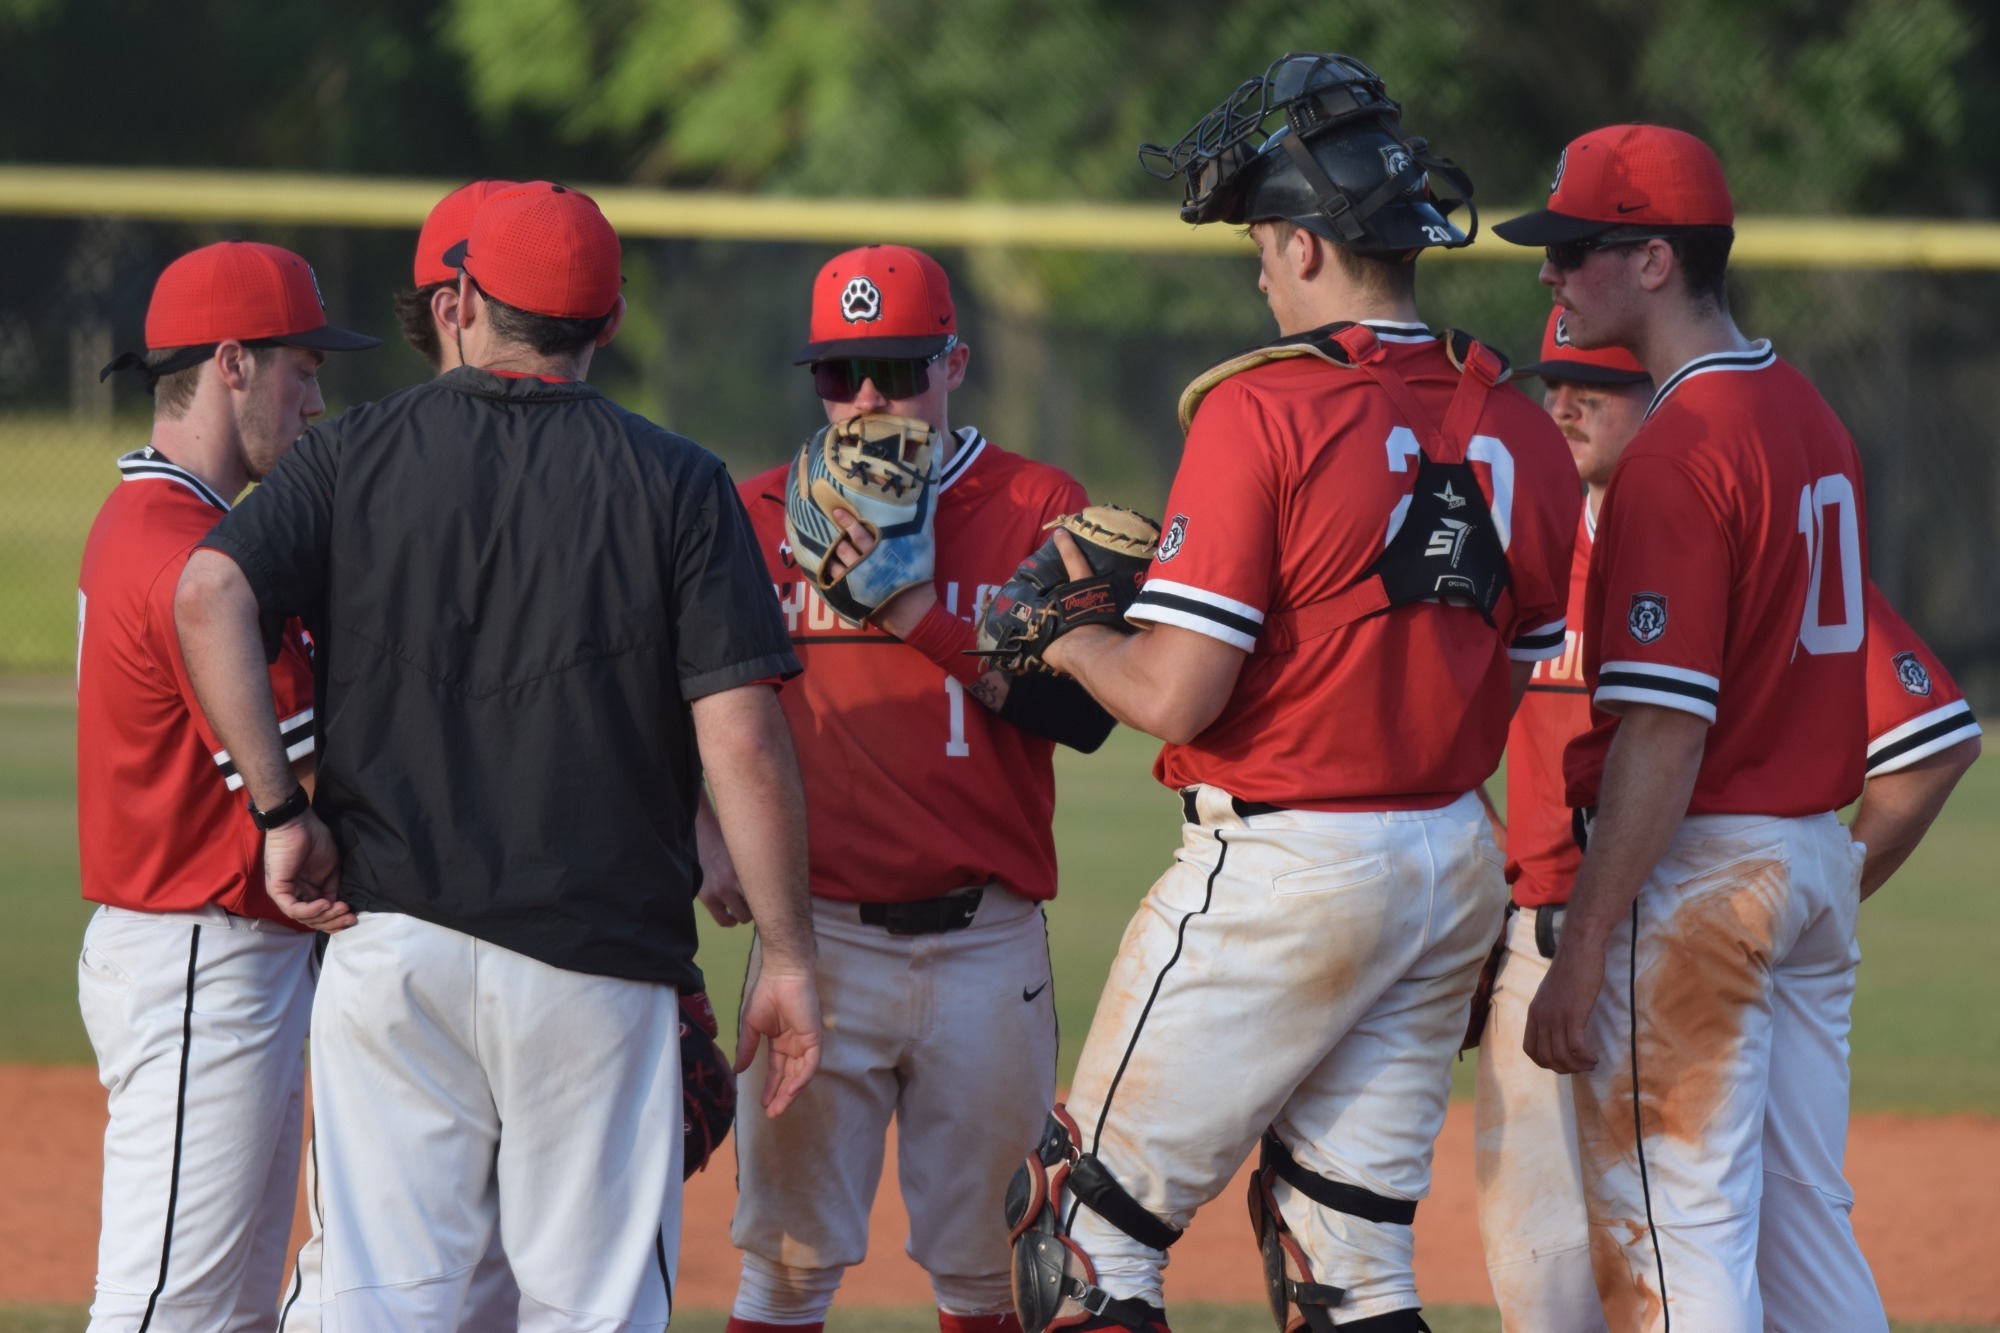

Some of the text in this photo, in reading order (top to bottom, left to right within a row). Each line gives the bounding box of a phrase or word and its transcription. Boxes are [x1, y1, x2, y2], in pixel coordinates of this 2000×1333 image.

[1421, 225, 1452, 242] 20
[1790, 473, 1864, 664] 10
[945, 674, 969, 757] 1
